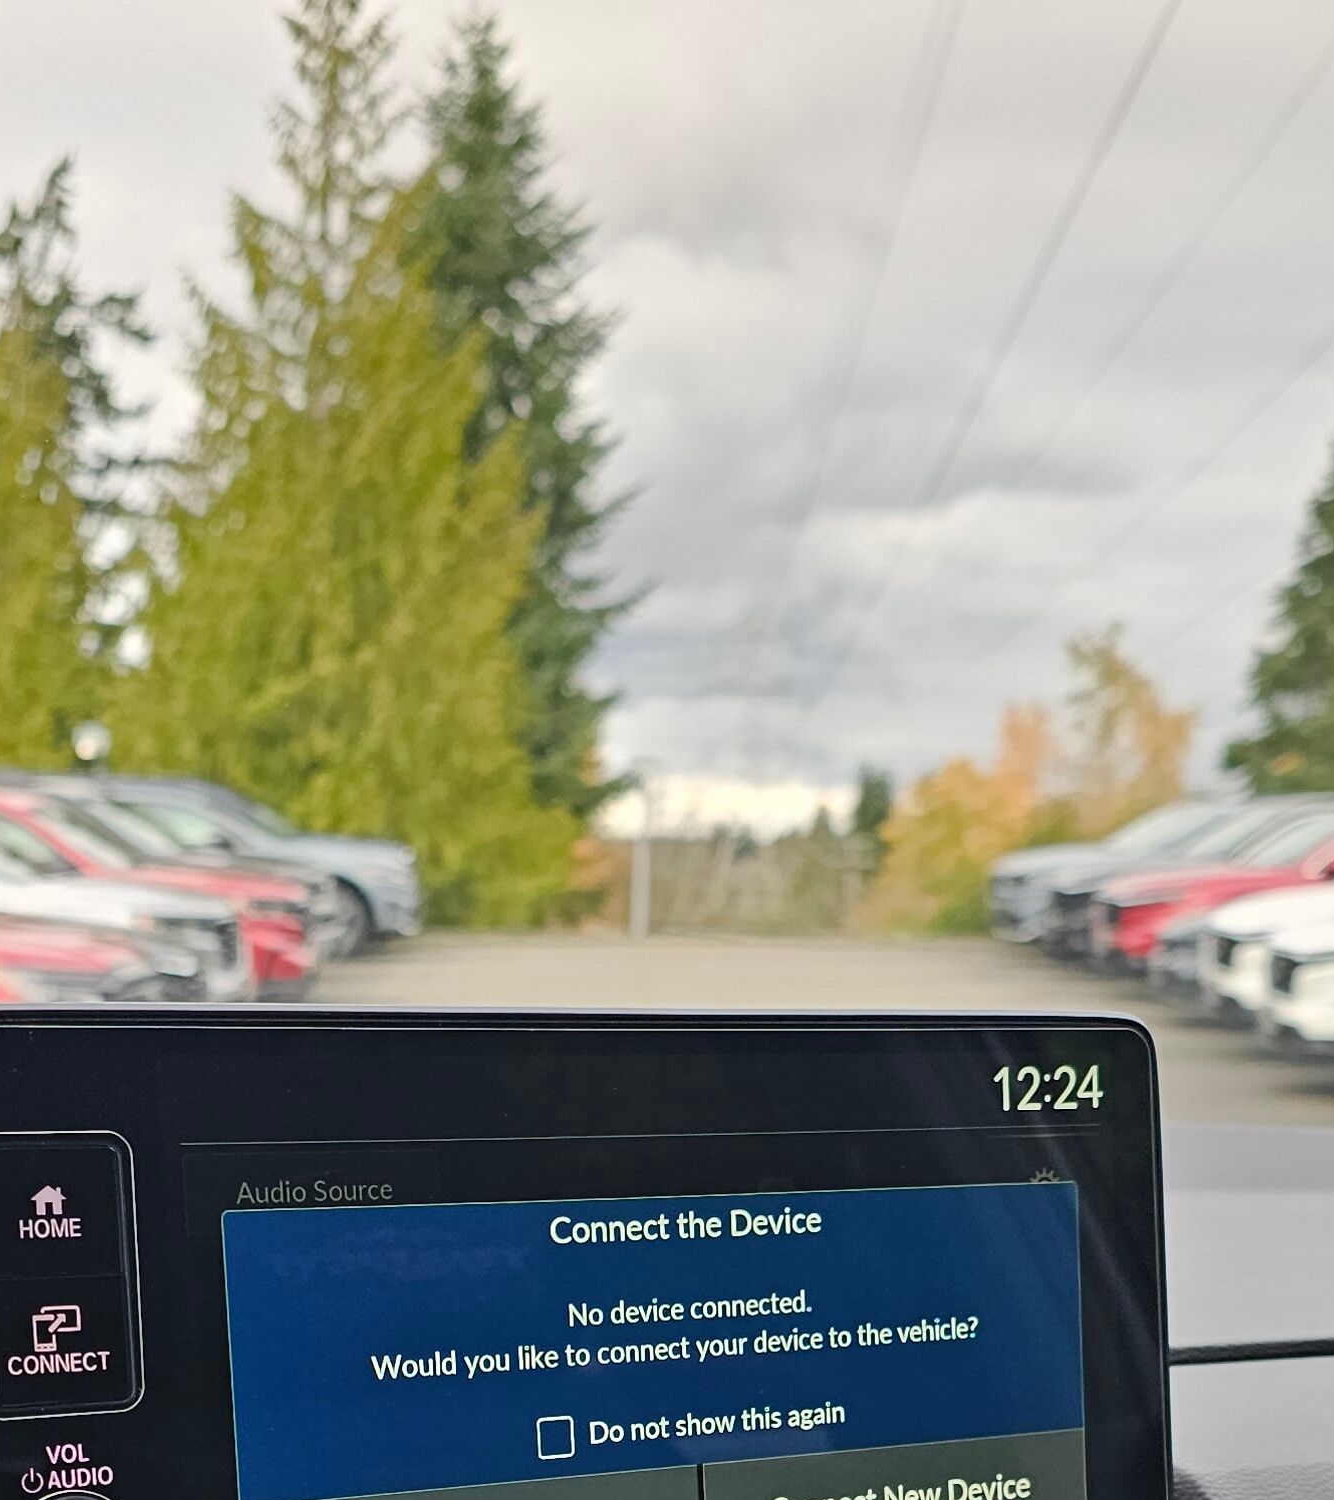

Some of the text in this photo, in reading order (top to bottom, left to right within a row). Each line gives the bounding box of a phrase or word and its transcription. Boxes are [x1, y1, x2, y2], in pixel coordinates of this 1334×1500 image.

[994, 1065, 1103, 1111] 12:24
[237, 1180, 392, 1204] Audio Source
[19, 1218, 81, 1238] HOME
[551, 1207, 822, 1243] Connect the Device
[569, 1289, 812, 1327] No device connected.
[8, 1352, 110, 1375] CONNECT
[371, 1316, 978, 1381] Would you like to connect your device to the vehicle?
[590, 1402, 845, 1444] Do not show this again
[46, 1444, 90, 1464] VOL
[48, 1466, 113, 1489] AUDIO
